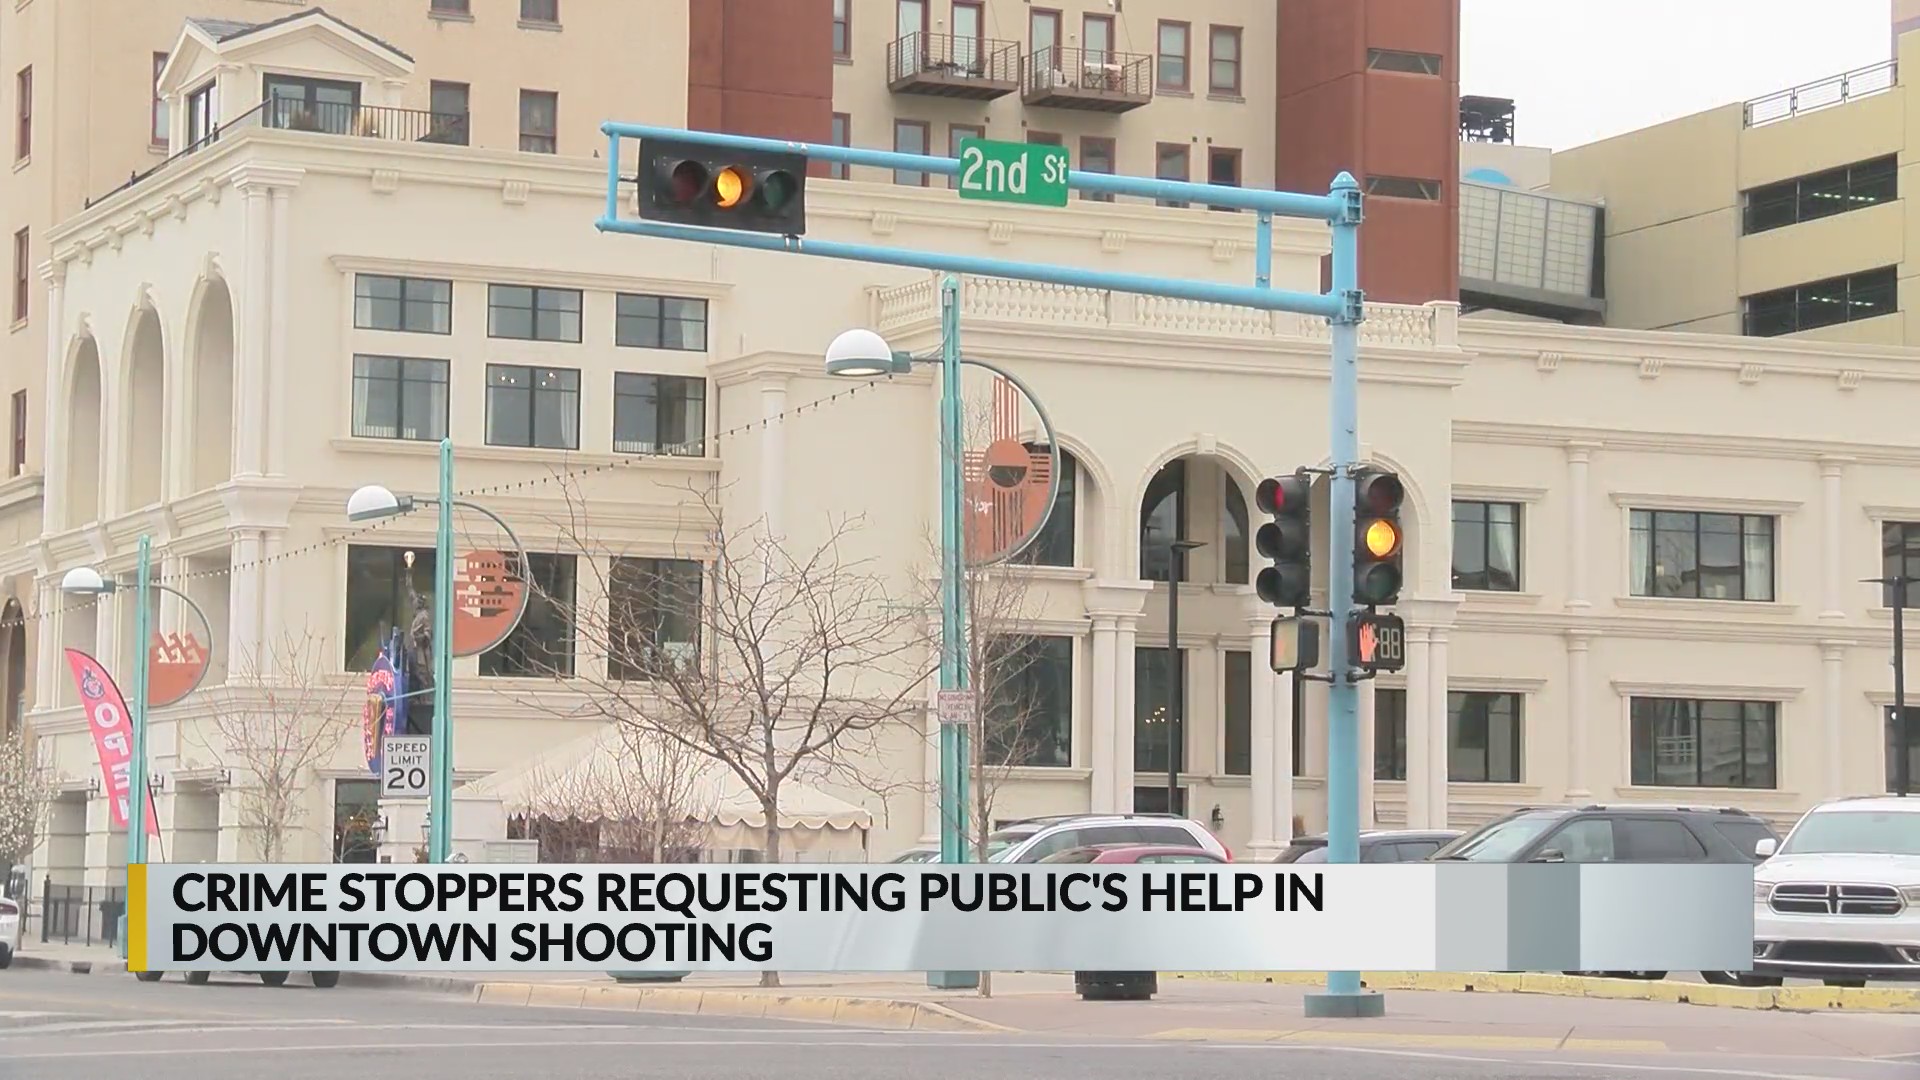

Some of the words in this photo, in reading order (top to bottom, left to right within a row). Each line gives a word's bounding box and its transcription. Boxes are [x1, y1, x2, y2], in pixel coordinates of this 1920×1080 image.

[961, 146, 1028, 194] 2nd
[1041, 154, 1067, 184] St
[386, 742, 428, 753] SPEED
[391, 755, 423, 766] LIMIT
[387, 767, 426, 790] 20
